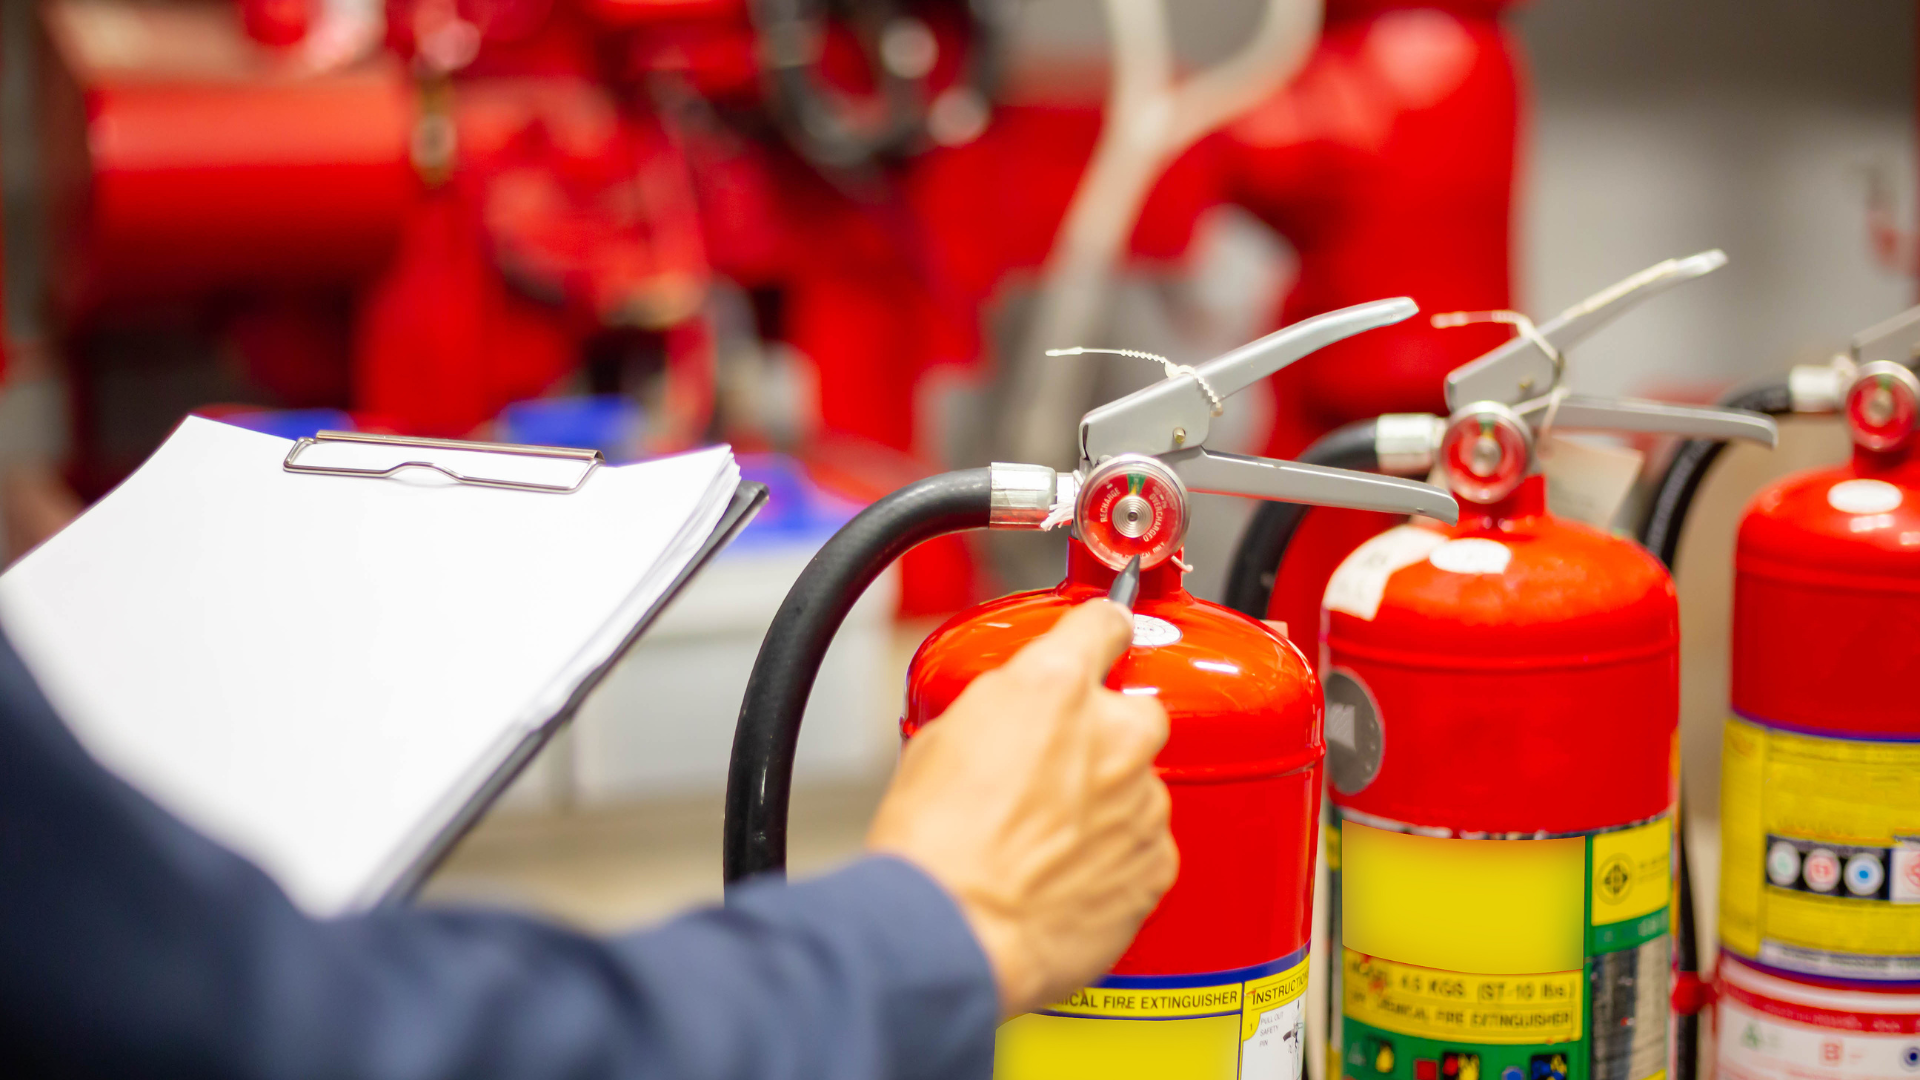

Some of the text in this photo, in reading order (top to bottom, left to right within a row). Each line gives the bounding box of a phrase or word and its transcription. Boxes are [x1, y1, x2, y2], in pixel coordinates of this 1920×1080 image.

[1100, 486, 1122, 523] RECHARGE
[1142, 492, 1164, 543] OVERCHARGED
[1103, 995, 1136, 1010] FIRE
[1140, 990, 1238, 1010] EXTINGUISHER
[1260, 1025, 1279, 1037] SAFETY
